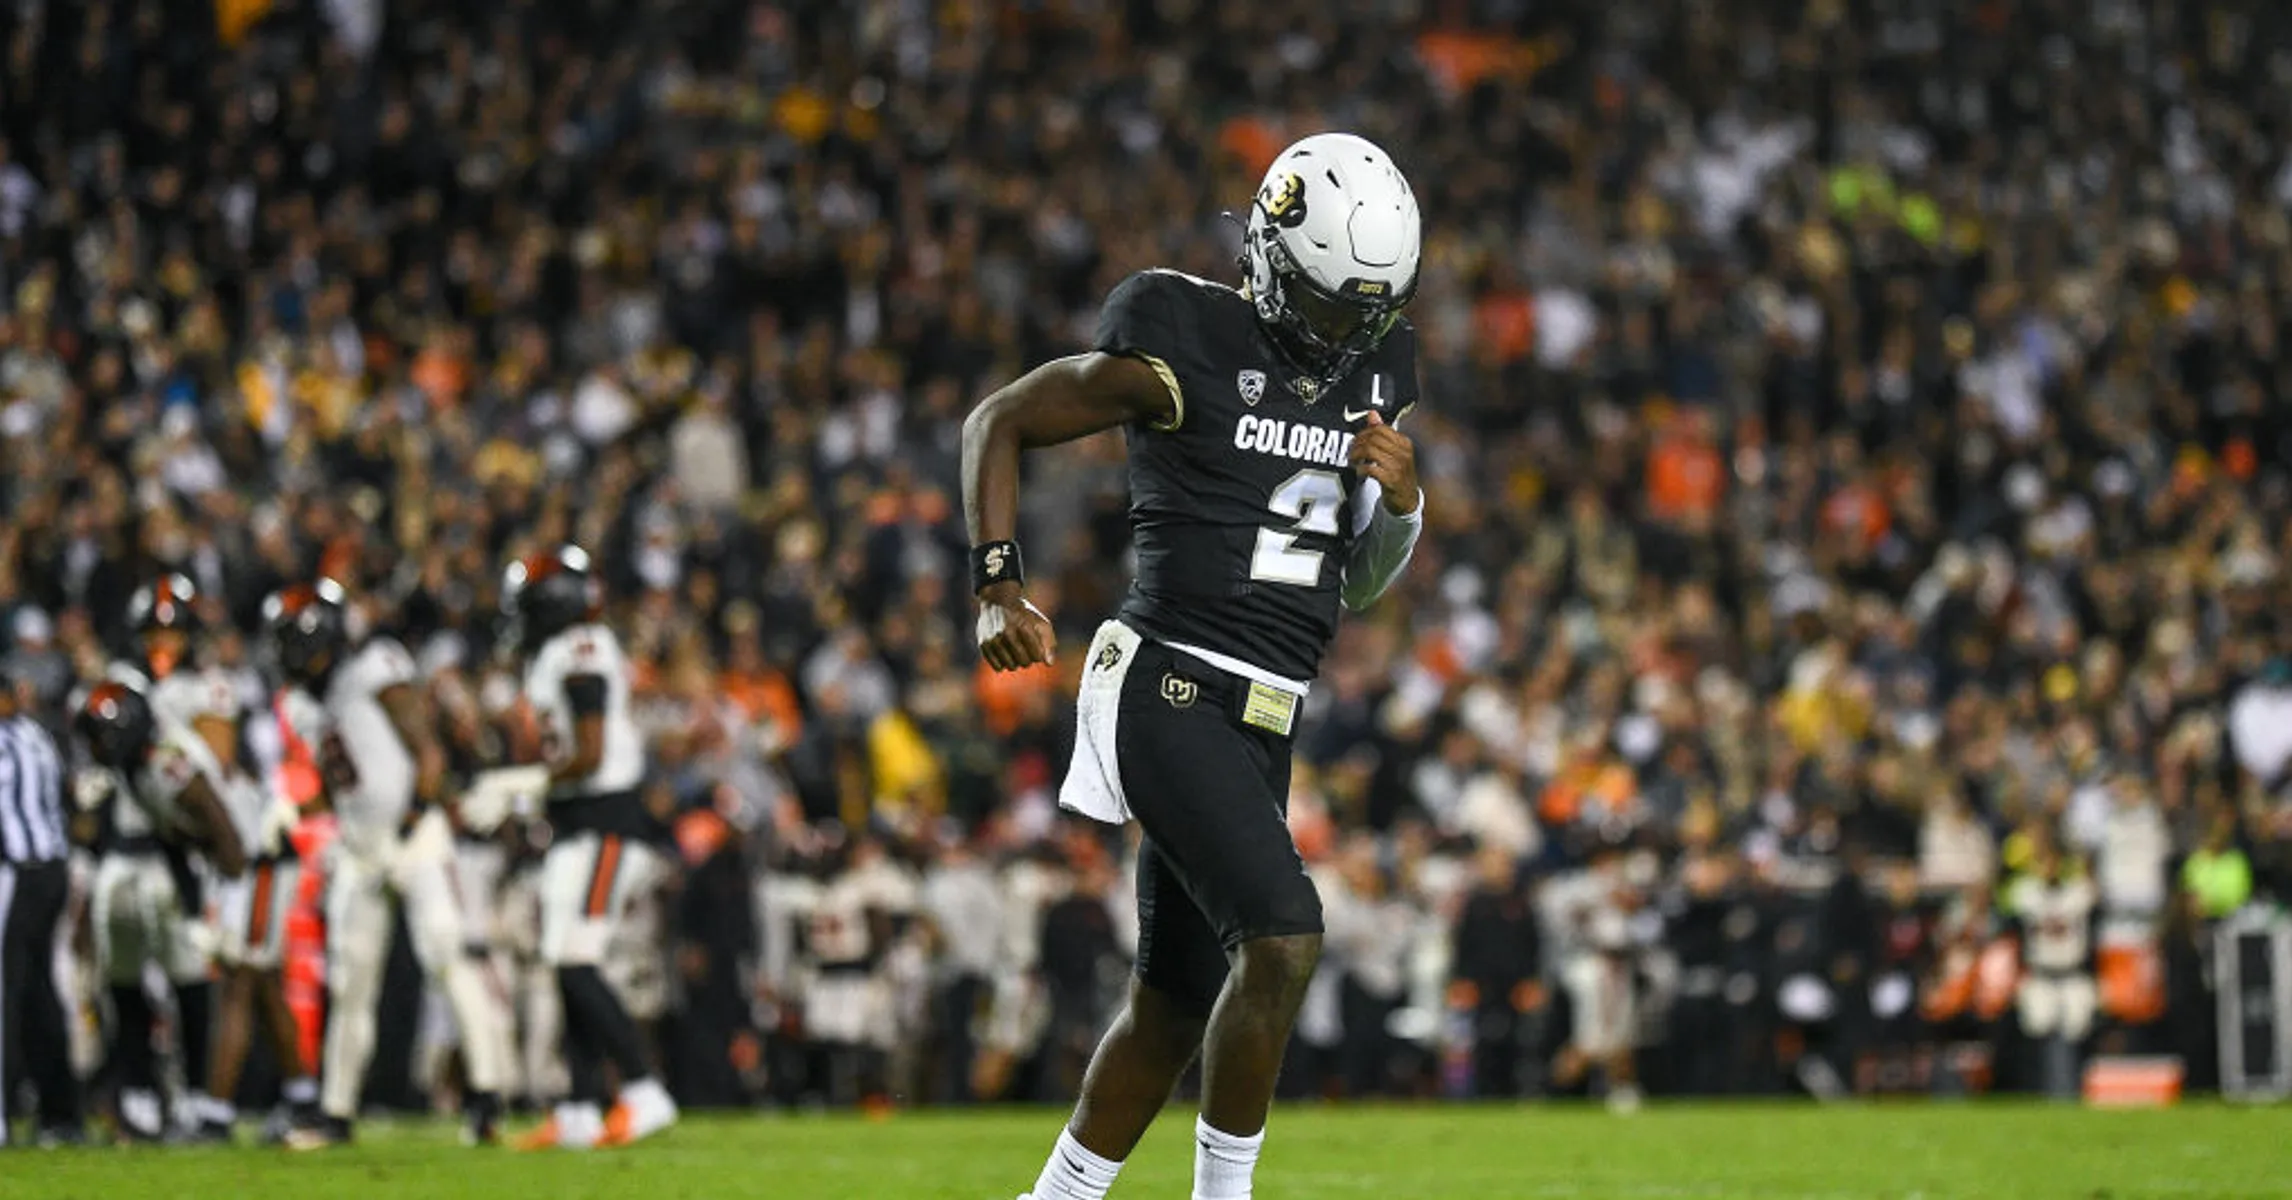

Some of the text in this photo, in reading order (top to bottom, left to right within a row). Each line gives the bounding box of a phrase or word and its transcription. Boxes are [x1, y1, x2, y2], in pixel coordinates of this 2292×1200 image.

[1371, 373, 1385, 406] L
[1234, 414, 1355, 467] COLORAD
[1250, 468, 1347, 587] 2
